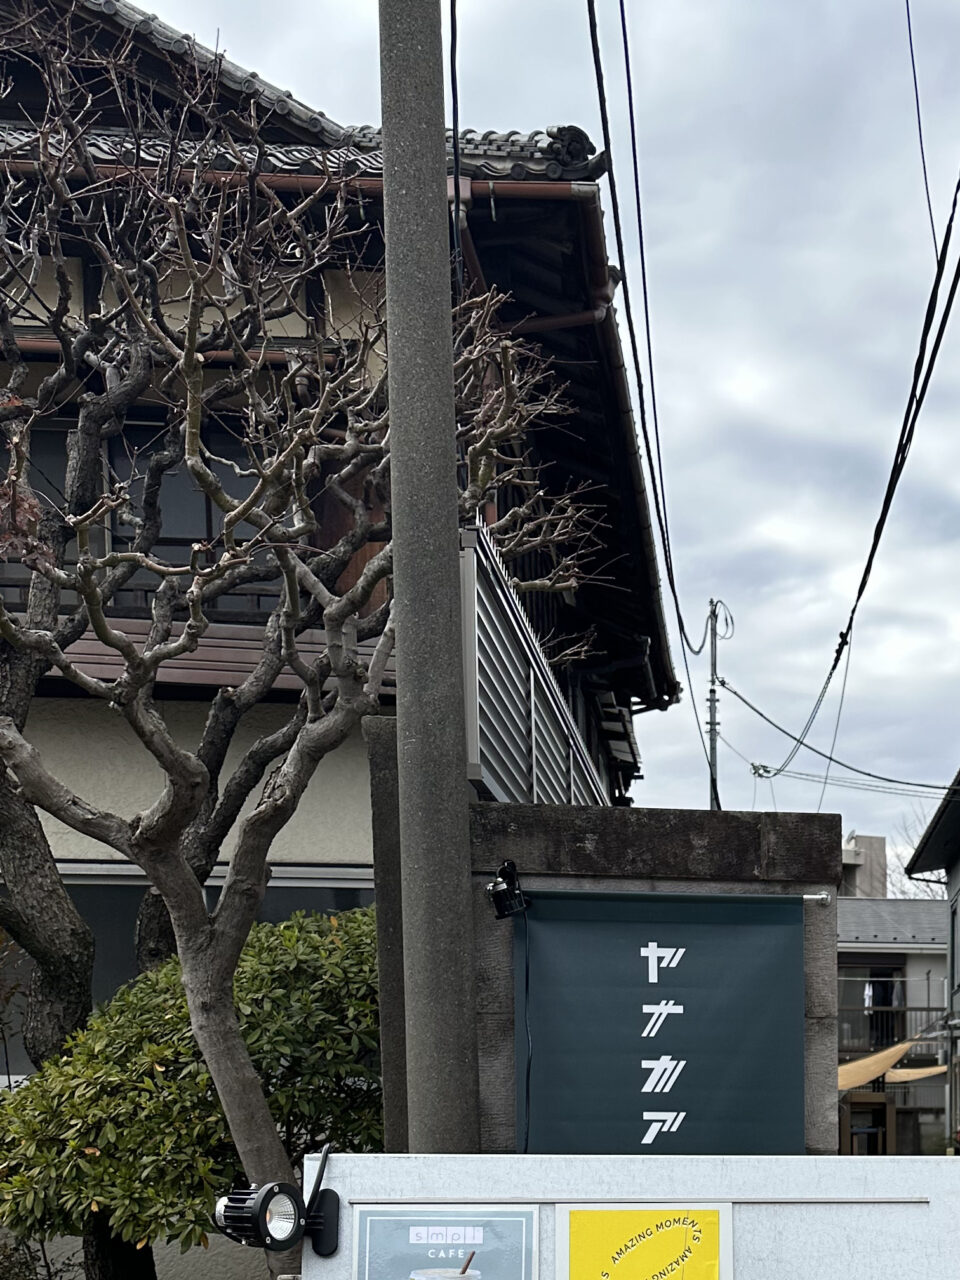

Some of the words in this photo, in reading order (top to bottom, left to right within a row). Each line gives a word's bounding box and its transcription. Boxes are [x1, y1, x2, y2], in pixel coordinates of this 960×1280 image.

[640, 942, 687, 1145] ヤナカア
[428, 1249, 466, 1259] CAFE
[610, 1227, 654, 1265] AMAZING
[655, 1216, 703, 1244] MOMENTS
